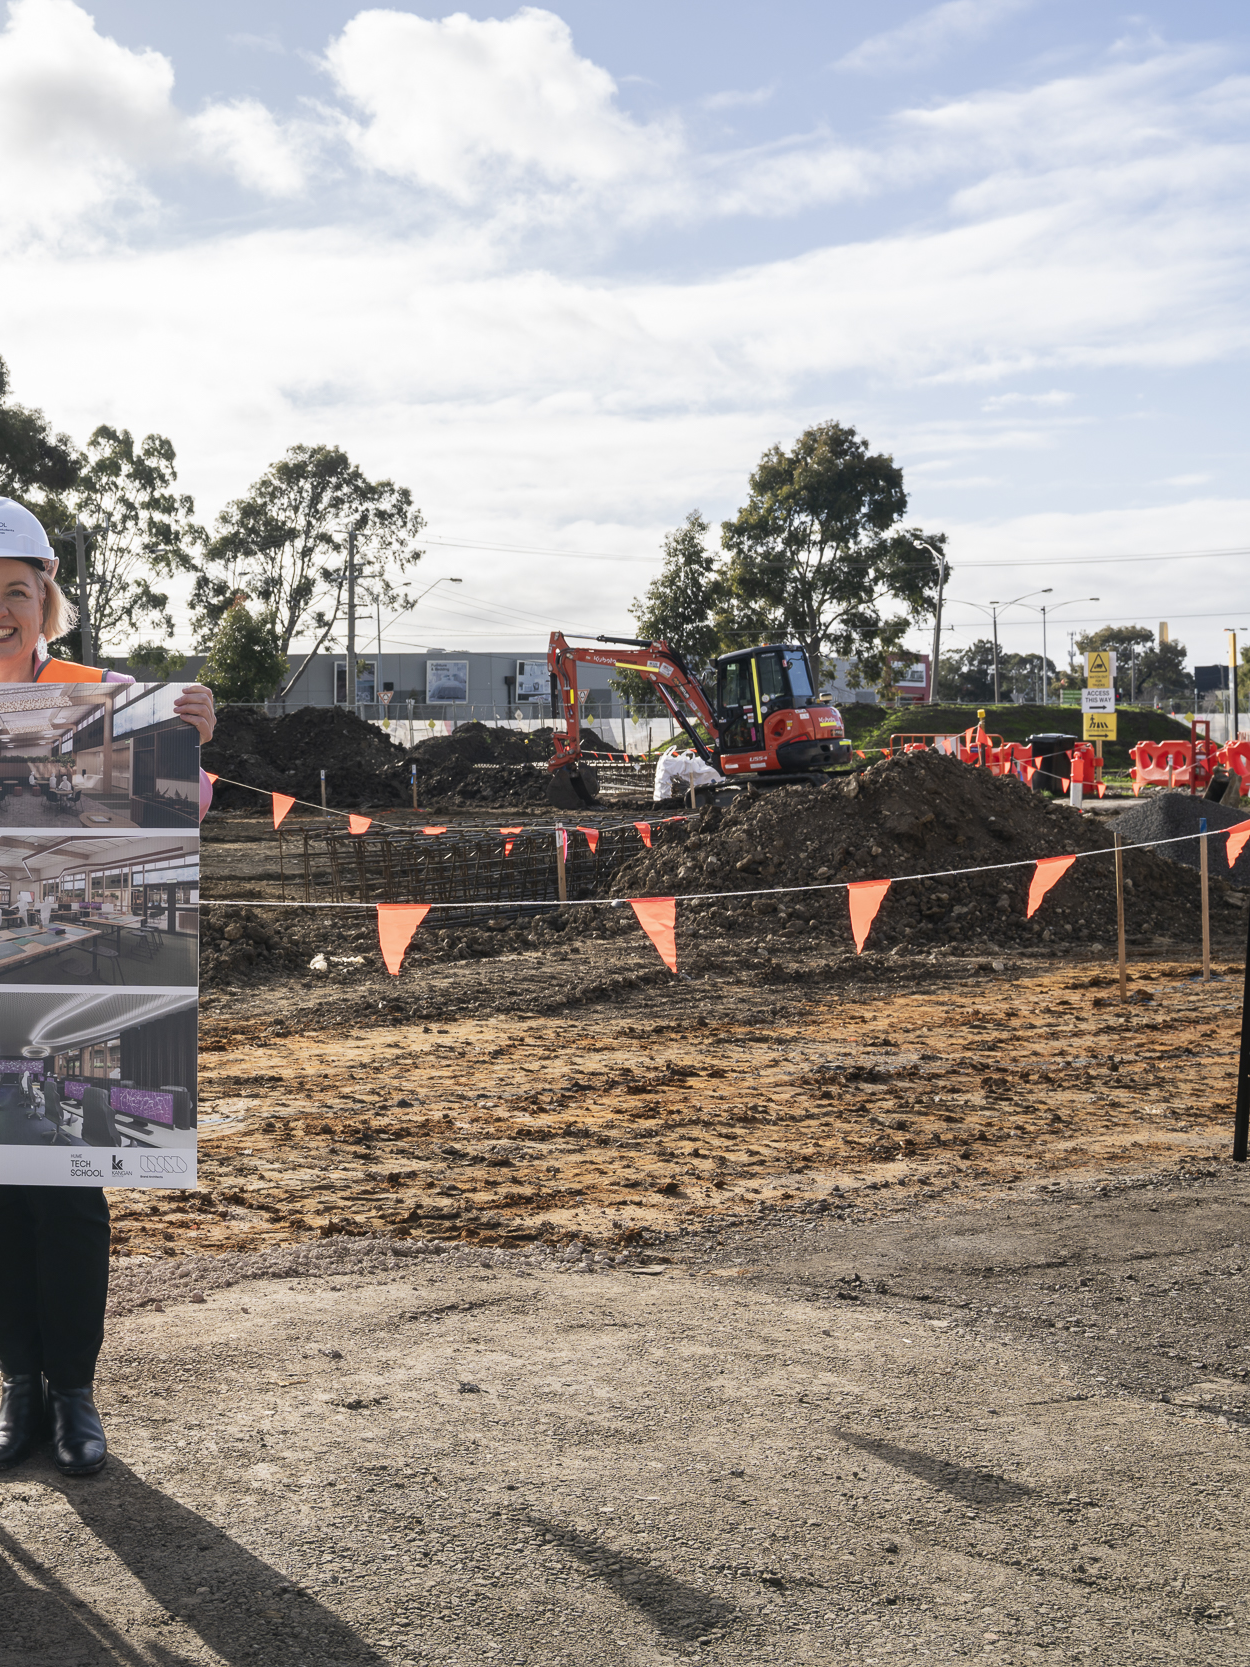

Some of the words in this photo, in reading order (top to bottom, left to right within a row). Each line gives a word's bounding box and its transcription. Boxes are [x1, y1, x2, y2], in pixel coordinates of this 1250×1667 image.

[593, 655, 617, 664] Kubota
[70, 1159, 91, 1168] TECH
[70, 1169, 104, 1178] SCHOOL
